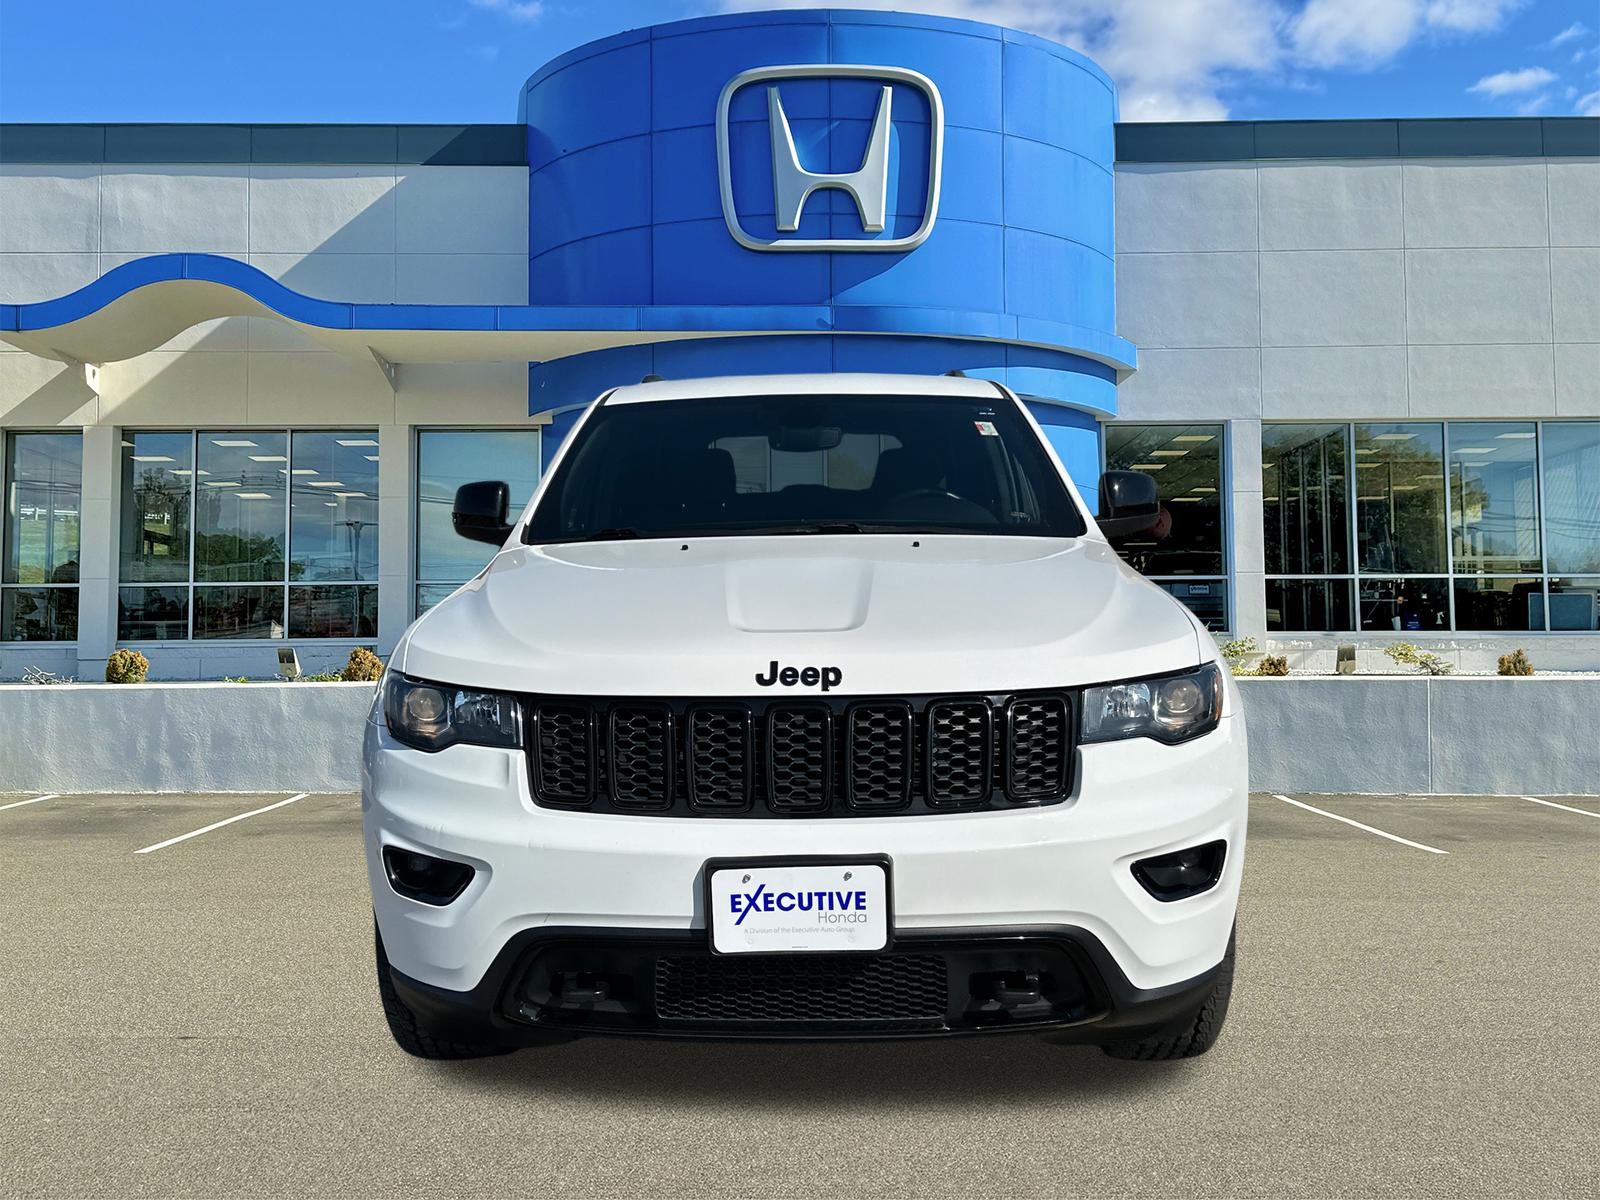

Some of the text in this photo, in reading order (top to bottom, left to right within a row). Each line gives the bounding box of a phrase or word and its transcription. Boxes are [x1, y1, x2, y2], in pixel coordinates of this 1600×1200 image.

[755, 660, 843, 692] Jeep
[730, 884, 867, 925] EXECUTIVE
[818, 911, 868, 924] Honda
[792, 926, 820, 934] Executive
